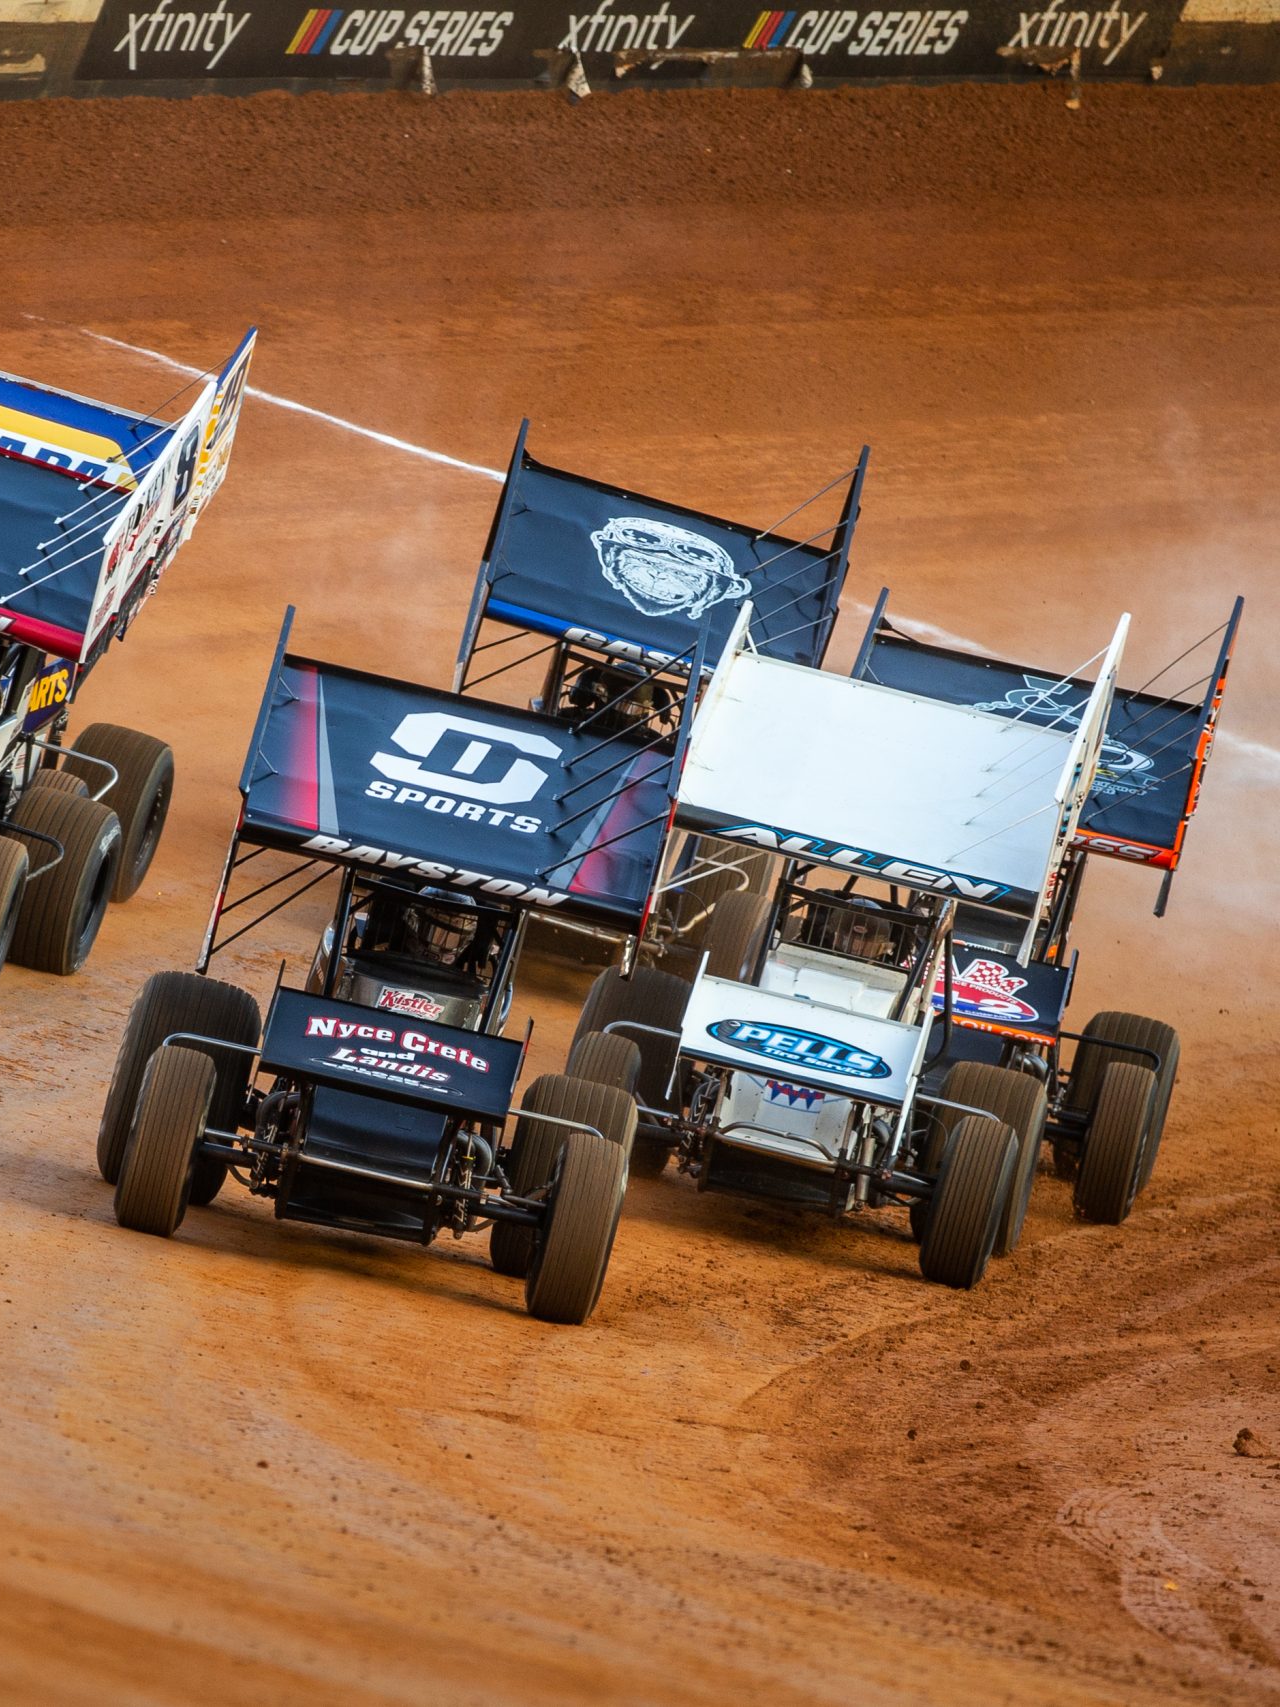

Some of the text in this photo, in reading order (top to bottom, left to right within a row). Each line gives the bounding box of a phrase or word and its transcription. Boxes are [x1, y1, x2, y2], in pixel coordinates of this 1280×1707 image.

[115, 1, 251, 70] xfinity
[330, 10, 514, 57] CUP SERIES
[561, 0, 695, 70] xfinity
[788, 10, 968, 57] CUP SERIES
[1008, 1, 1147, 66] xfinity
[28, 668, 70, 713] ARTS
[364, 780, 542, 834] SPORTS
[299, 834, 571, 907] BAYSTON
[719, 826, 998, 899] ALLEN
[380, 990, 444, 1014] Kistler
[306, 1017, 490, 1073] Nyce Crete
[331, 1047, 451, 1083] Landis
[360, 1047, 416, 1061] and
[730, 1023, 882, 1070] PELLS
[804, 1056, 873, 1079] Service
